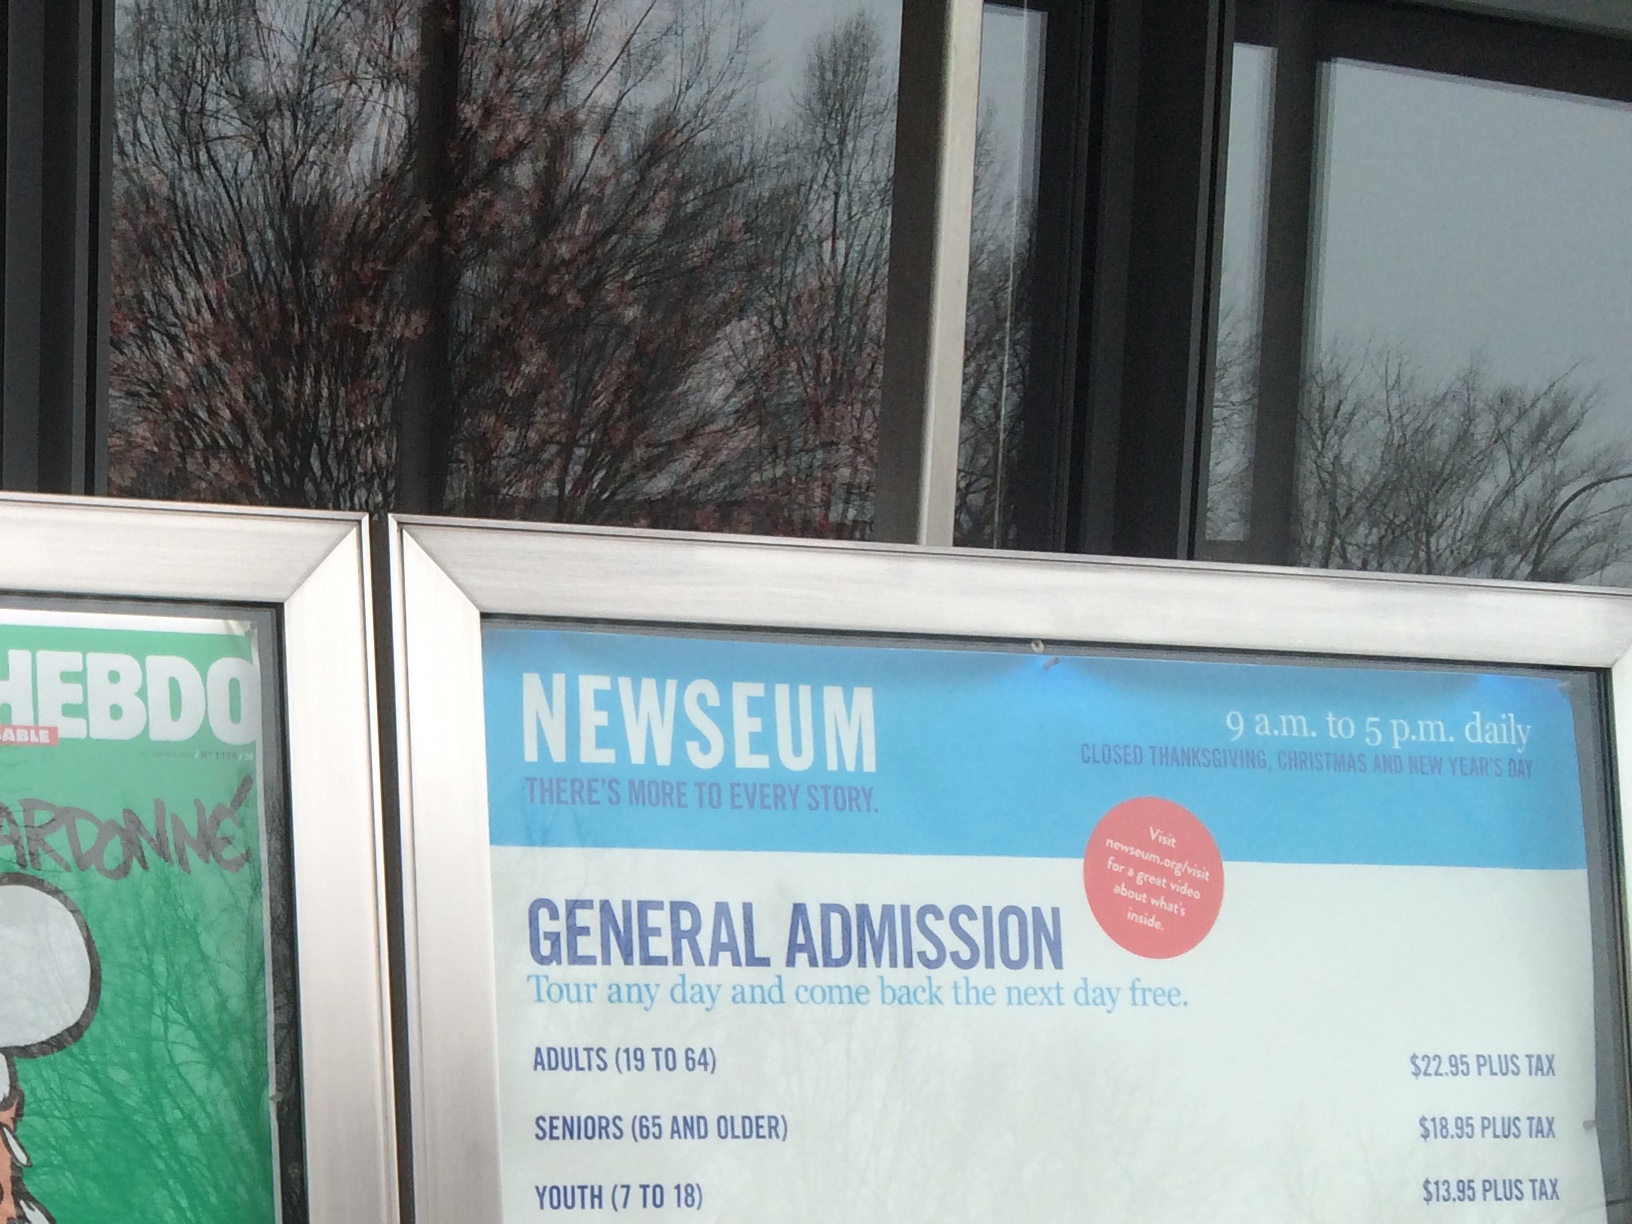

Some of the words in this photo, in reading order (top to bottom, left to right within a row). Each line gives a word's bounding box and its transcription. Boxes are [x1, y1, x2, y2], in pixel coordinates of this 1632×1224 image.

[522, 672, 877, 773] NEWSEUM
[1226, 711, 1244, 741] 9
[1255, 714, 1317, 737] a.m.
[1325, 712, 1355, 739] to
[1365, 717, 1382, 746] 5
[1390, 719, 1455, 749] p.m.
[1464, 711, 1532, 754] daily
[1080, 743, 1143, 765] CLOSED
[1148, 746, 1272, 769] THANKSGIVING,
[1277, 750, 1367, 772] CHRISTMAS
[1373, 754, 1403, 774] AND
[1408, 756, 1443, 775] NEW
[1448, 757, 1503, 777] YEAR'S
[1507, 757, 1534, 780] DAY
[524, 777, 621, 805] THERE'S
[628, 779, 689, 808] MORE
[694, 782, 722, 809] TO
[729, 782, 800, 810] EVERY
[806, 784, 879, 812] STORY.
[1149, 826, 1176, 848] Visit
[1105, 838, 1210, 881] newseum.org/visit
[1107, 856, 1125, 872] for
[1127, 868, 1134, 877] a
[1136, 872, 1167, 888] great
[1170, 880, 1201, 899] video
[1113, 883, 1147, 903] about
[1151, 896, 1186, 916] what's
[528, 899, 771, 967] GENERAL
[785, 904, 1063, 969] ADMISSION
[1127, 907, 1164, 930] inside.
[526, 974, 598, 1003] Tour
[607, 983, 661, 1012] any
[669, 973, 722, 1012] day
[731, 974, 786, 1004] and
[794, 985, 870, 1005] come
[878, 975, 944, 1005] back
[952, 976, 996, 1005] the
[1006, 982, 1065, 1006] next
[1073, 977, 1121, 1013] day
[1129, 978, 1188, 1007] free.
[533, 1047, 608, 1071] ADULTS
[615, 1047, 645, 1073] (19
[651, 1047, 677, 1071] TO
[684, 1048, 716, 1074] 64)
[1410, 1053, 1470, 1078] $22.95
[1476, 1054, 1521, 1076] PLUS
[1524, 1054, 1556, 1077] TAX
[534, 1115, 624, 1140] SENIORS
[631, 1115, 663, 1142] (65
[670, 1115, 708, 1139] AND
[716, 1115, 787, 1141] OLDER)
[1419, 1116, 1475, 1141] $18.95
[1481, 1116, 1521, 1139] PLUS
[1526, 1116, 1556, 1139] TAX
[535, 1185, 603, 1210] YOUTH
[611, 1184, 631, 1212] (7
[639, 1184, 664, 1208] TO
[674, 1183, 703, 1210] 18)
[1422, 1179, 1476, 1204] $13.95
[1482, 1179, 1524, 1201] PLUS
[1528, 1178, 1560, 1200] TAX
